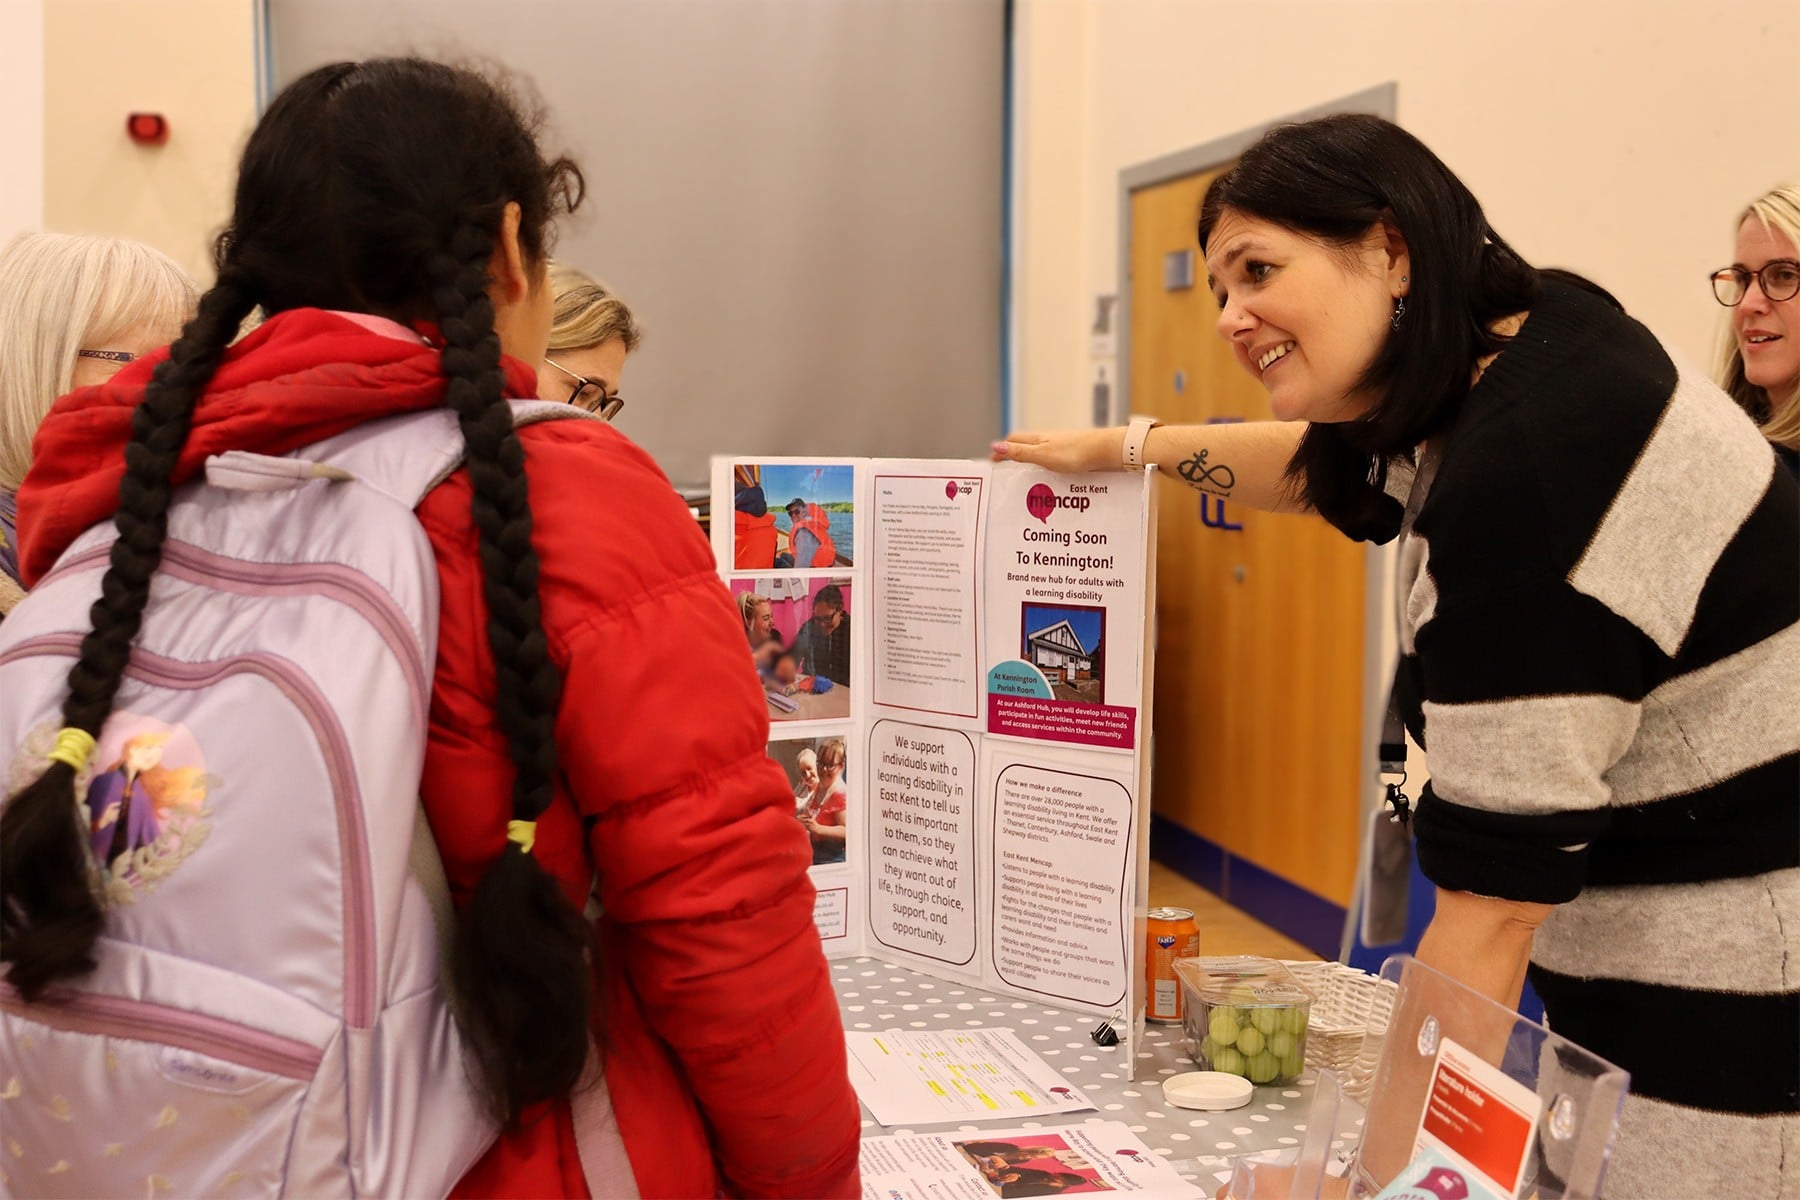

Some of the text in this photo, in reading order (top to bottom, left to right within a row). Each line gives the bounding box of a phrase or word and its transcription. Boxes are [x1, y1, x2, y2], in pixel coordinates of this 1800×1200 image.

[1070, 485, 1108, 494] East Kent
[1029, 495, 1090, 512] mencap
[1023, 529, 1107, 548] Coming Soon
[1018, 552, 1113, 571] To Kennington!
[1007, 573, 1029, 583] Brand
[1049, 575, 1063, 584] hub
[1065, 576, 1076, 585] for
[1079, 577, 1104, 587] adults
[1106, 579, 1124, 588] with
[1032, 589, 1064, 600] learning
[1066, 590, 1102, 602] disability
[1002, 675, 1037, 684] Kennington
[1075, 708, 1100, 717] develop
[1087, 731, 1123, 739] community.
[895, 737, 944, 756] We support
[883, 753, 958, 776] individuals with a
[878, 770, 963, 797] learning disability in
[1052, 787, 1082, 797] difference
[880, 789, 960, 814] East Kent to tell us
[1004, 801, 1026, 811] learning
[1027, 805, 1051, 816] disability
[1052, 809, 1068, 818] living
[1044, 798, 1064, 806] 28,000
[882, 809, 958, 833] what is important
[1012, 813, 1035, 821] essential
[1056, 820, 1089, 830] throughout
[885, 827, 955, 853] to them, so they
[1003, 828, 1050, 842] Shepway districts.
[1007, 820, 1027, 829] Thanet,
[1027, 824, 1059, 836] Canterbury,
[1060, 830, 1084, 840] Ashford,
[1086, 835, 1103, 843] Swale
[882, 847, 958, 871] can achieve what
[1030, 858, 1053, 868] Mencap:
[884, 864, 956, 889] they want out of
[1004, 864, 1022, 873] Listens
[1066, 877, 1088, 888] learning
[1090, 881, 1115, 893] disability
[878, 879, 964, 911] life, through choice,
[1002, 884, 1024, 896] disability
[1061, 898, 1074, 906] their
[1075, 901, 1087, 909] lives
[1005, 875, 1026, 885] Supports
[1027, 881, 1044, 889] people
[1046, 884, 1060, 894] living
[1079, 891, 1102, 903] learning
[893, 904, 948, 925] support, and
[1001, 905, 1022, 916] learning
[1023, 910, 1046, 922] disability
[1059, 918, 1071, 926] their
[1072, 921, 1095, 932] families
[1004, 896, 1019, 905] Fights
[1038, 904, 1060, 914] changes
[1074, 913, 1092, 922] people
[893, 924, 946, 945] opportunity.
